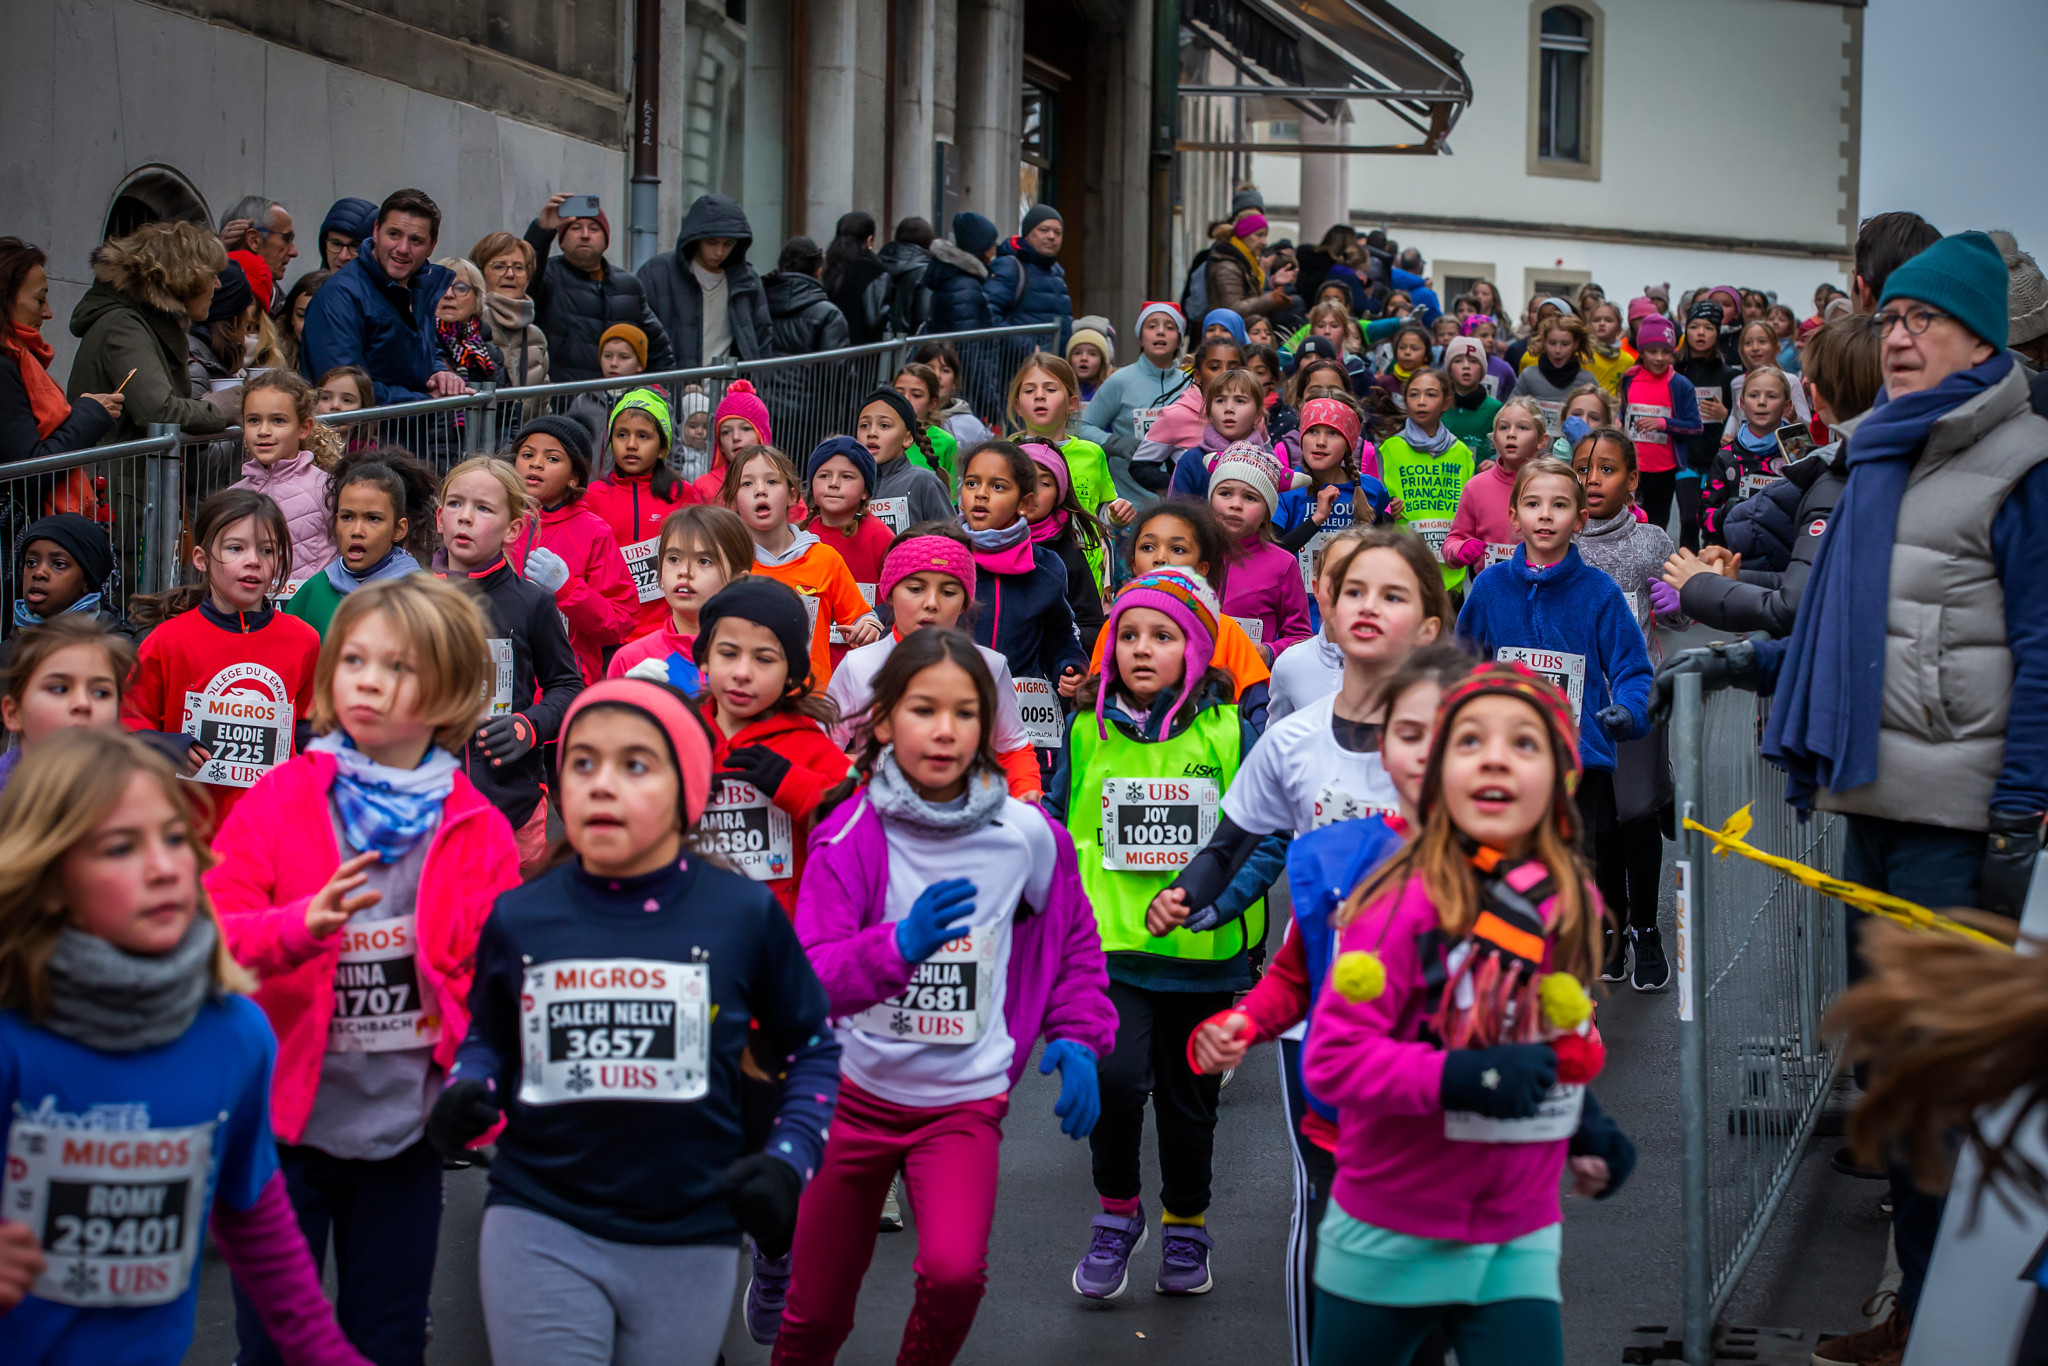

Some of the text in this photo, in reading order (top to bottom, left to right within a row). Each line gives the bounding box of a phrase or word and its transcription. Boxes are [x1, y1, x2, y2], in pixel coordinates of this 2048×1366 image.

[1399, 464, 1440, 477] ÉCOLE
[1400, 476, 1461, 489] PRIMAIRE
[1402, 487, 1461, 500] FRANÇAISE
[869, 501, 891, 512] ROS
[1412, 499, 1459, 513] GENÈVE
[624, 544, 651, 561] UBS
[628, 561, 649, 575] NIA
[1531, 653, 1563, 670] UBS
[246, 667, 261, 676] DU
[1013, 681, 1049, 694] MIGROS
[208, 701, 275, 720] MIGROS
[1020, 706, 1055, 723] 0095
[216, 724, 265, 744] ELODIE
[211, 740, 265, 764] 7225
[231, 765, 264, 782] UBS
[1148, 783, 1190, 801] UBS
[700, 811, 746, 831] AMRA
[1142, 807, 1170, 824] JOY
[1123, 824, 1193, 845] 10030
[1125, 851, 1189, 865] MIGROS
[340, 926, 407, 953] GROS
[555, 968, 667, 990] MIGROS
[335, 984, 411, 1017] 1707
[890, 985, 968, 1011] 7681
[550, 1001, 674, 1028] SALEH NELLY
[917, 1015, 964, 1036] UBS
[565, 1027, 656, 1059] 3657
[600, 1064, 658, 1090] UBS
[61, 1138, 190, 1171] MIGROS
[87, 1184, 169, 1217] ROMY
[52, 1213, 181, 1255] 29401
[108, 1260, 171, 1296] UBS
